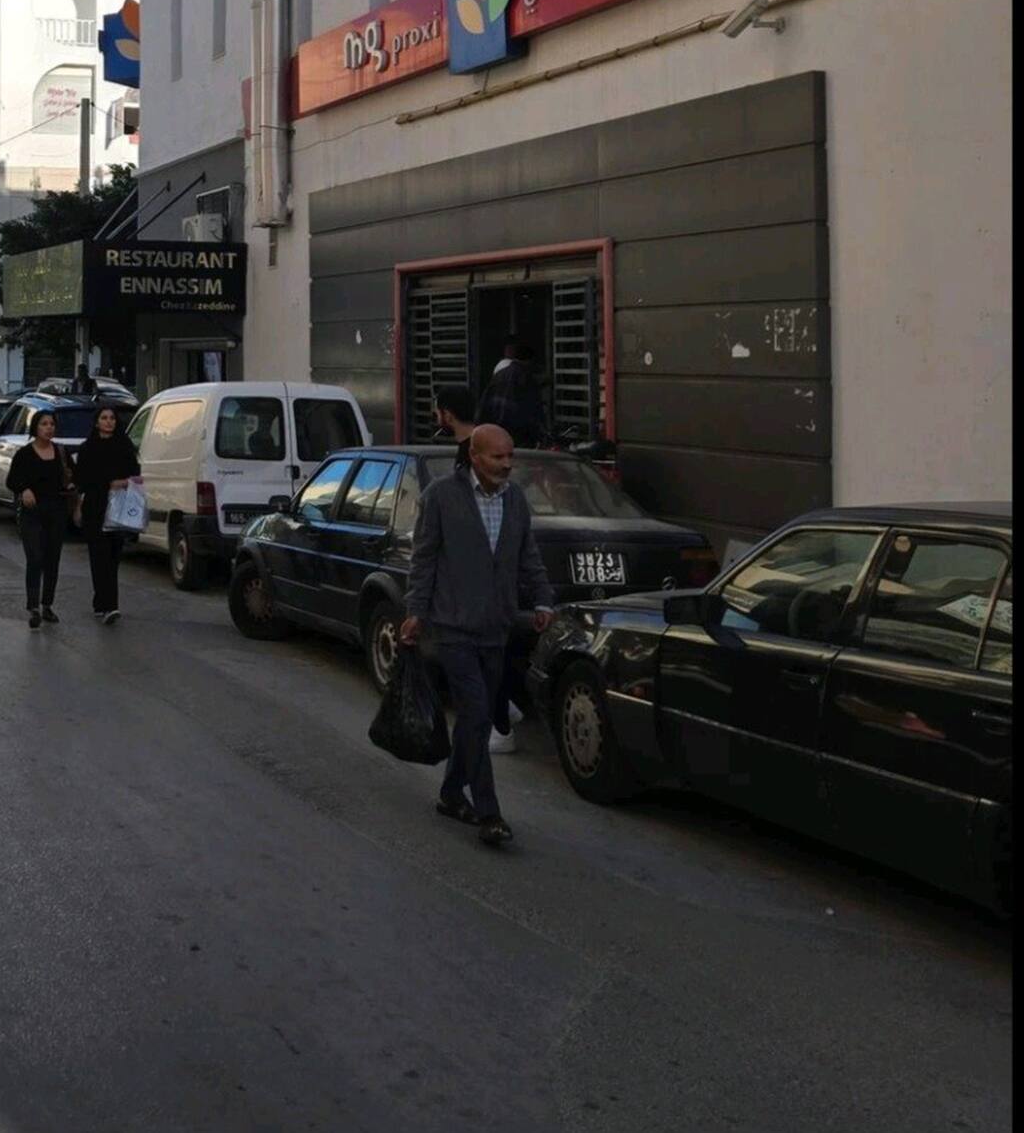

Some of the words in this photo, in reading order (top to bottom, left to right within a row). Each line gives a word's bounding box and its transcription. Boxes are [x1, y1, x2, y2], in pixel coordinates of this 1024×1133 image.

[343, 19, 388, 72] mg
[392, 11, 441, 66] proxi
[105, 249, 237, 269] RESTAURANT
[120, 276, 223, 295] ENNASSIM
[578, 566, 606, 583] 208
